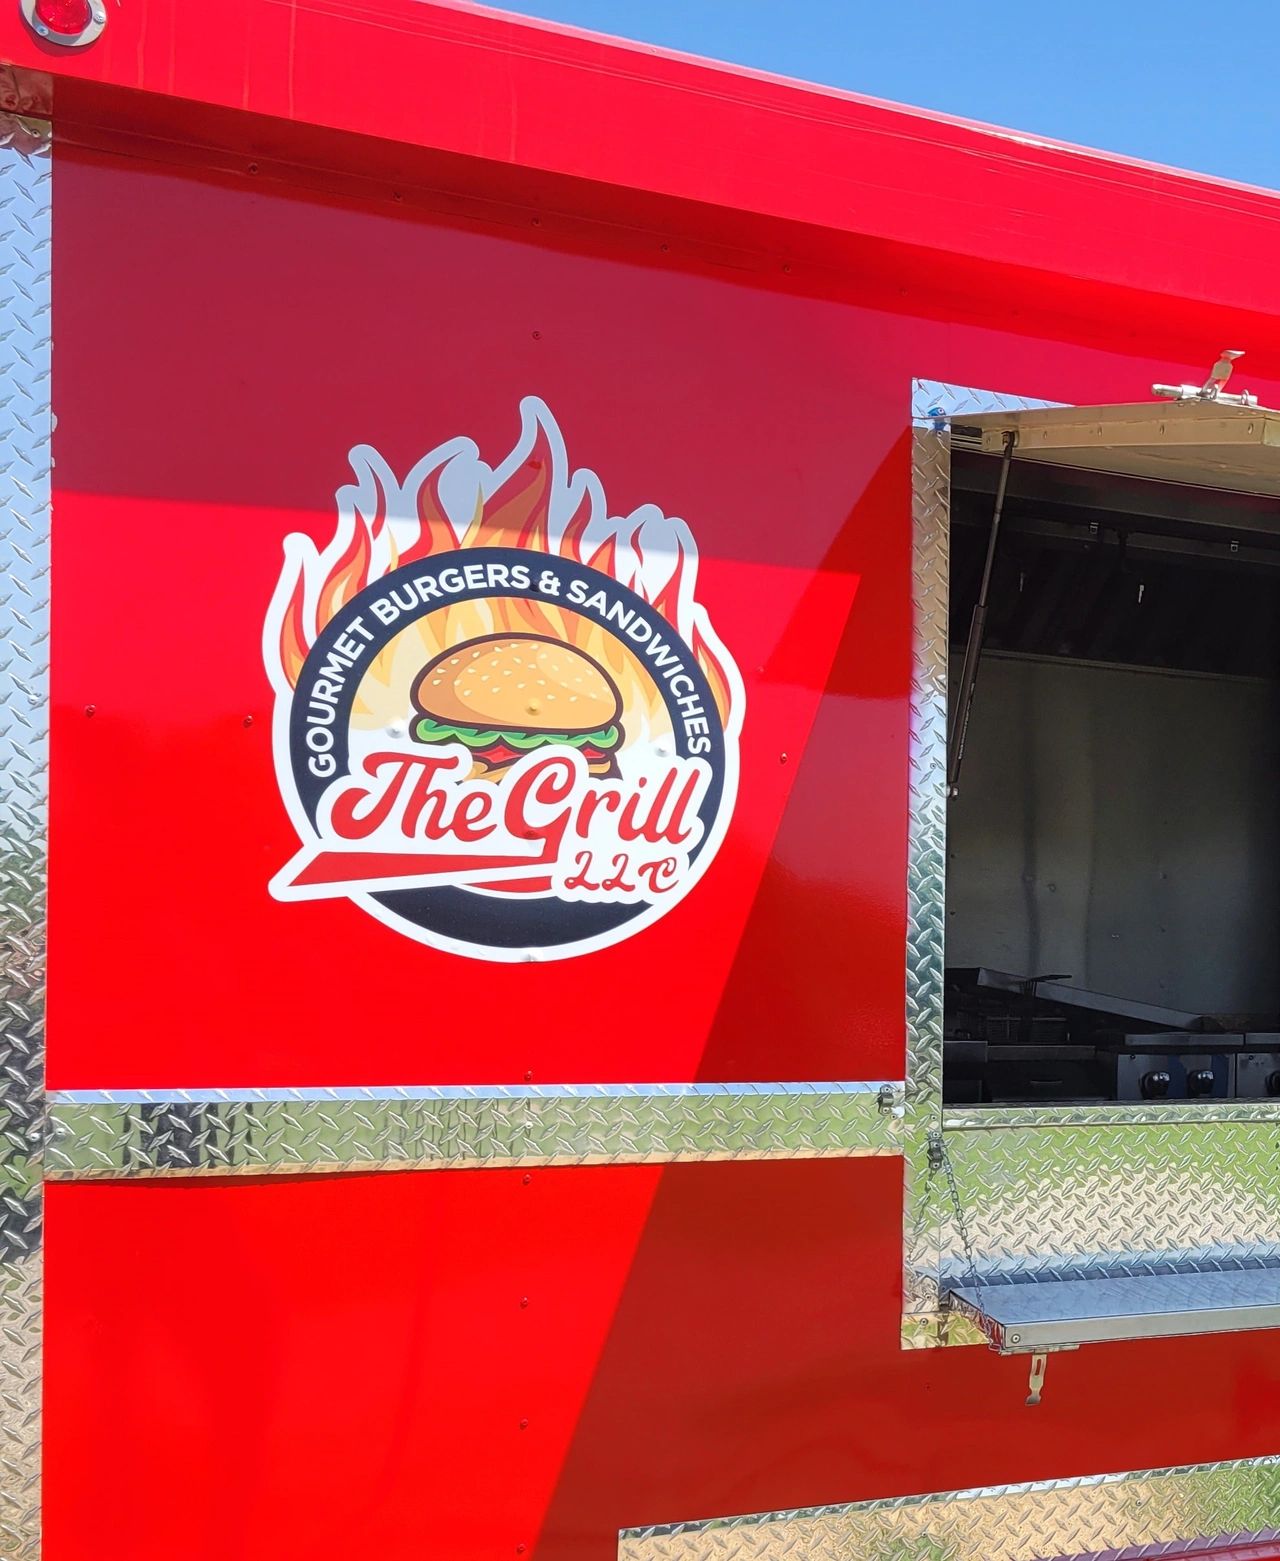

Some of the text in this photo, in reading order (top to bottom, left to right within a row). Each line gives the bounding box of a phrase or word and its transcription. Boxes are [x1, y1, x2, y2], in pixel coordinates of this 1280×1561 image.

[306, 563, 711, 778] GOURMET BURGERS & SANDWICHES
[330, 751, 701, 859] The Grill
[564, 850, 680, 894] LLC
